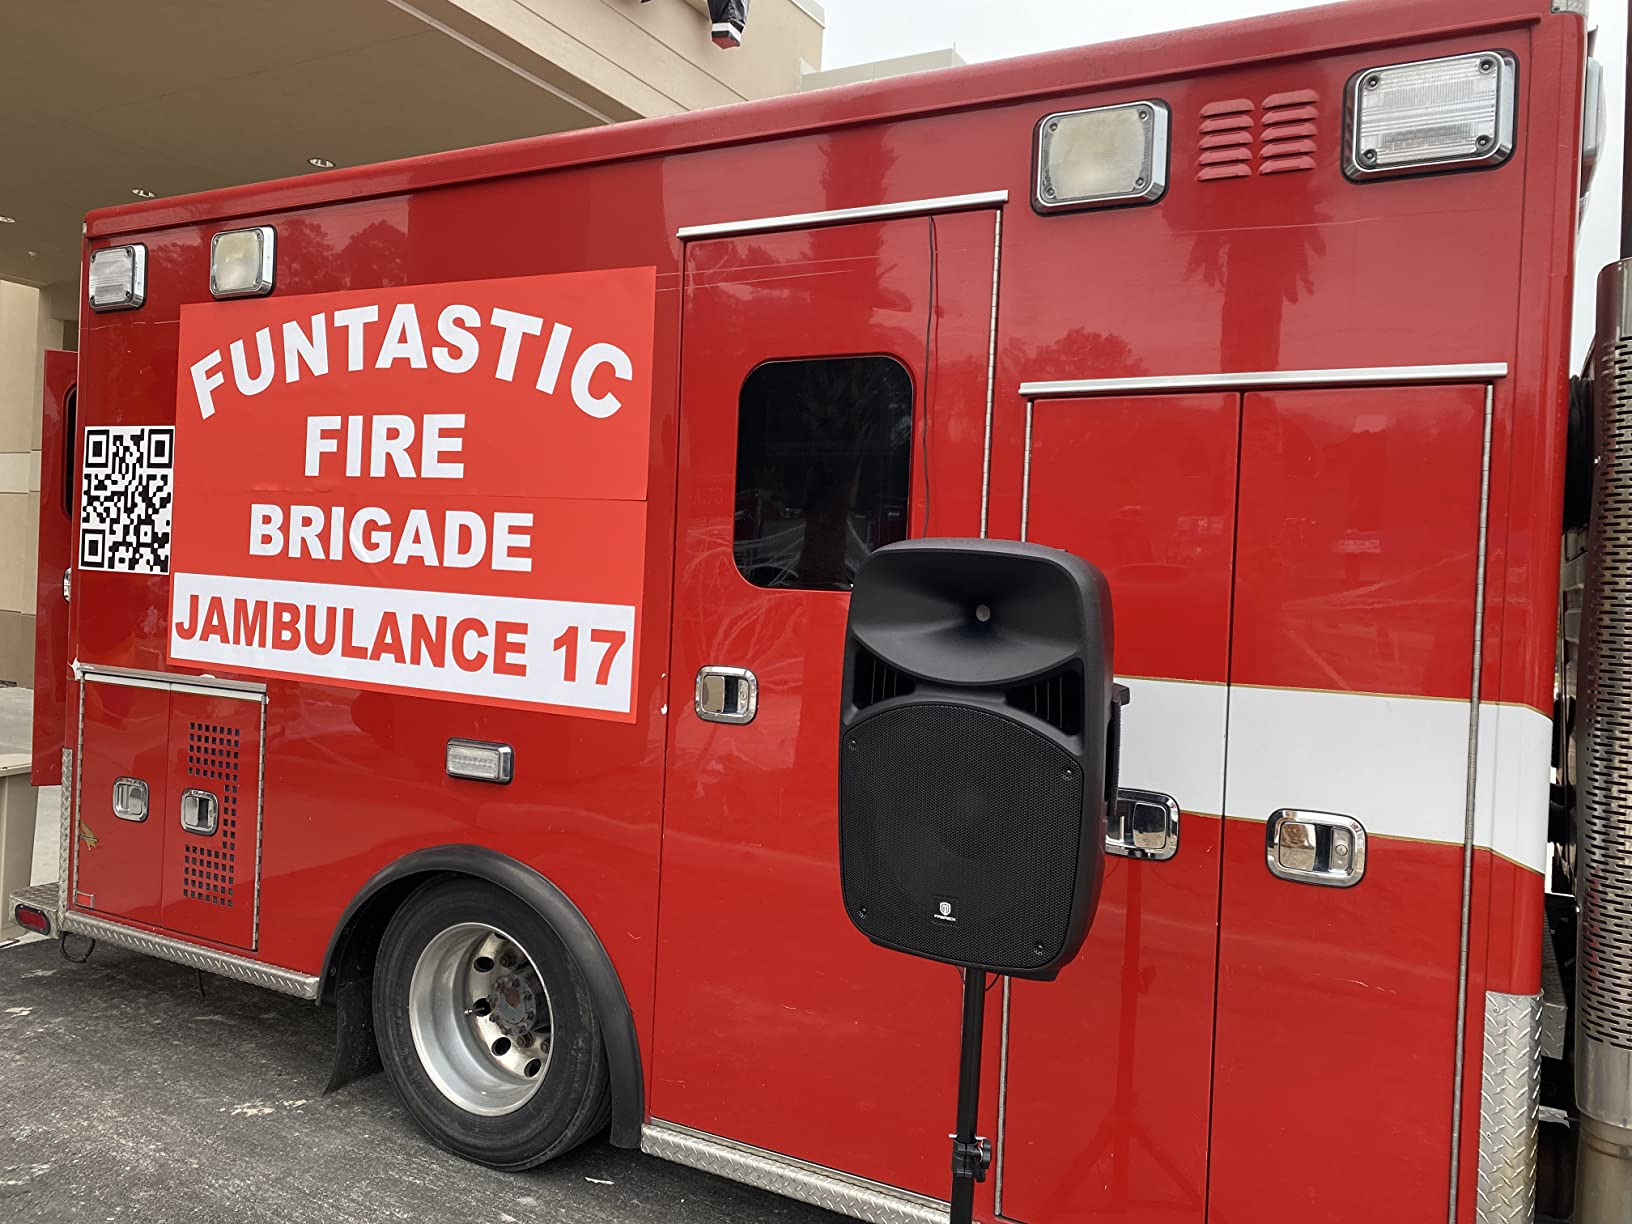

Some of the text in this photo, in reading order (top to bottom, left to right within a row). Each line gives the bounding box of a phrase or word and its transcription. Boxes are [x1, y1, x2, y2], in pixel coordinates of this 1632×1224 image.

[190, 303, 633, 420] FUNTASTIC
[304, 413, 466, 479] FIRE
[249, 503, 534, 572] BRIGADE
[175, 594, 627, 686] JAMBULANCE 17
